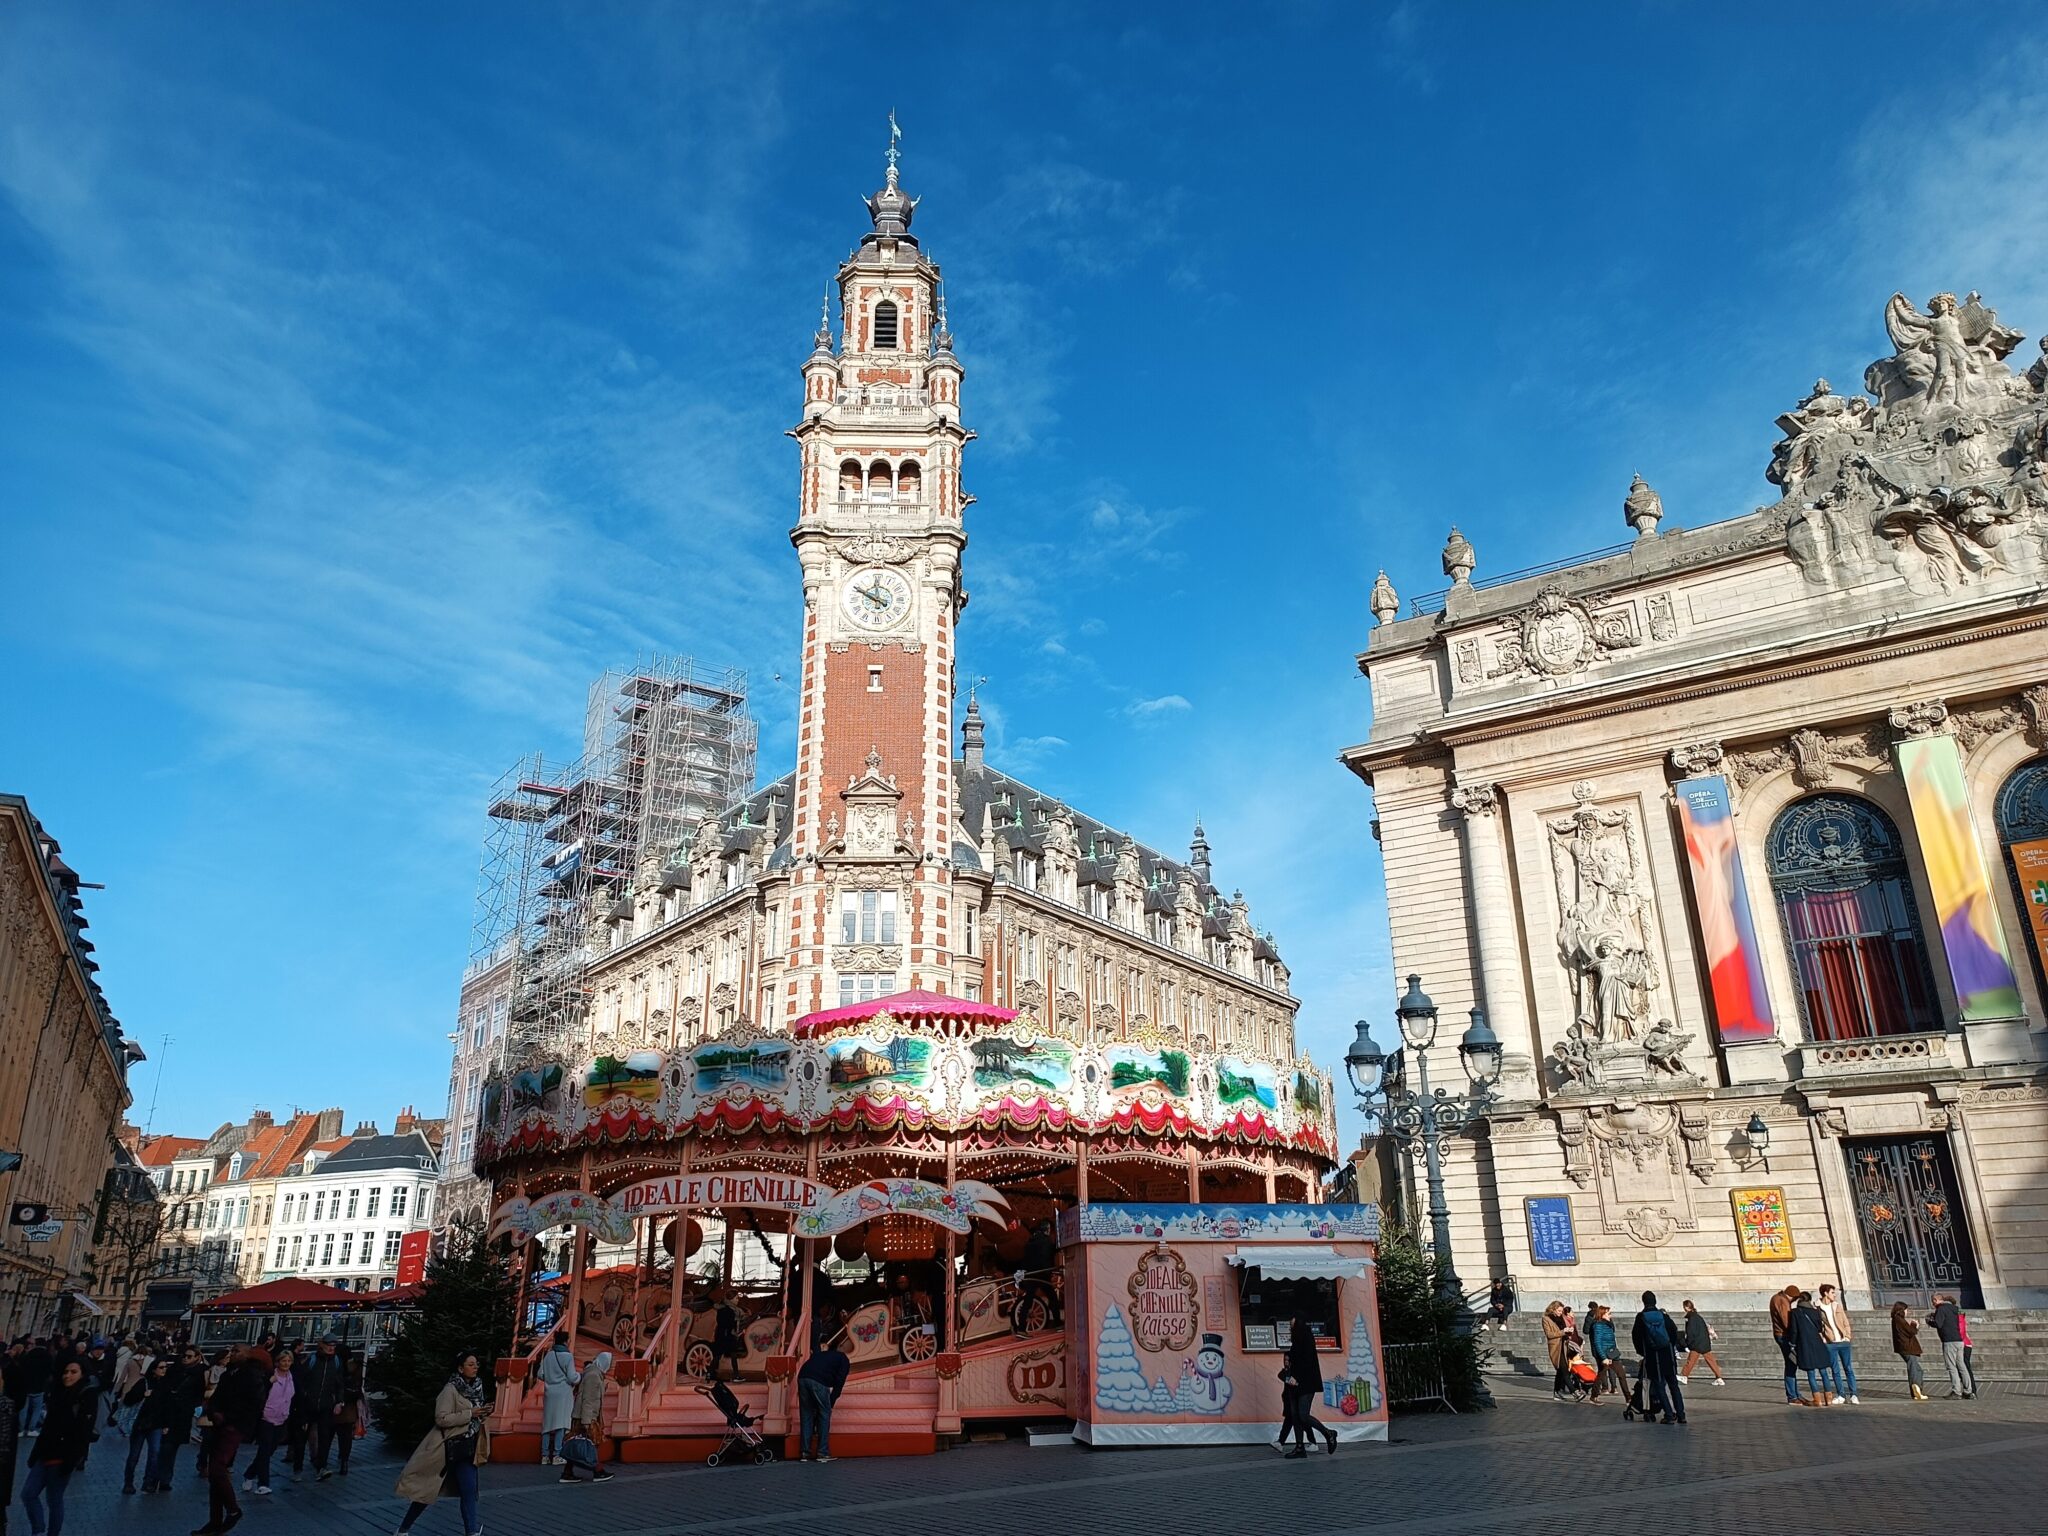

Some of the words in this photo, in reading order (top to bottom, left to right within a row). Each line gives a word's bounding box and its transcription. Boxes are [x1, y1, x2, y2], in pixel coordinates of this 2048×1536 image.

[1701, 800, 1718, 808] LILLE
[624, 1178, 701, 1213] IDEALE
[707, 1176, 817, 1208] CHENILLE
[630, 1205, 644, 1214] 1922
[783, 1201, 801, 1210] 1922
[1738, 1204, 1766, 1212] HAPPY
[1763, 1220, 1785, 1229] DAYS
[31, 1233, 50, 1241] Beer
[1742, 1229, 1759, 1238] DES
[1744, 1236, 1782, 1245] ENFANTS
[1140, 1292, 1190, 1314] CHENILLE
